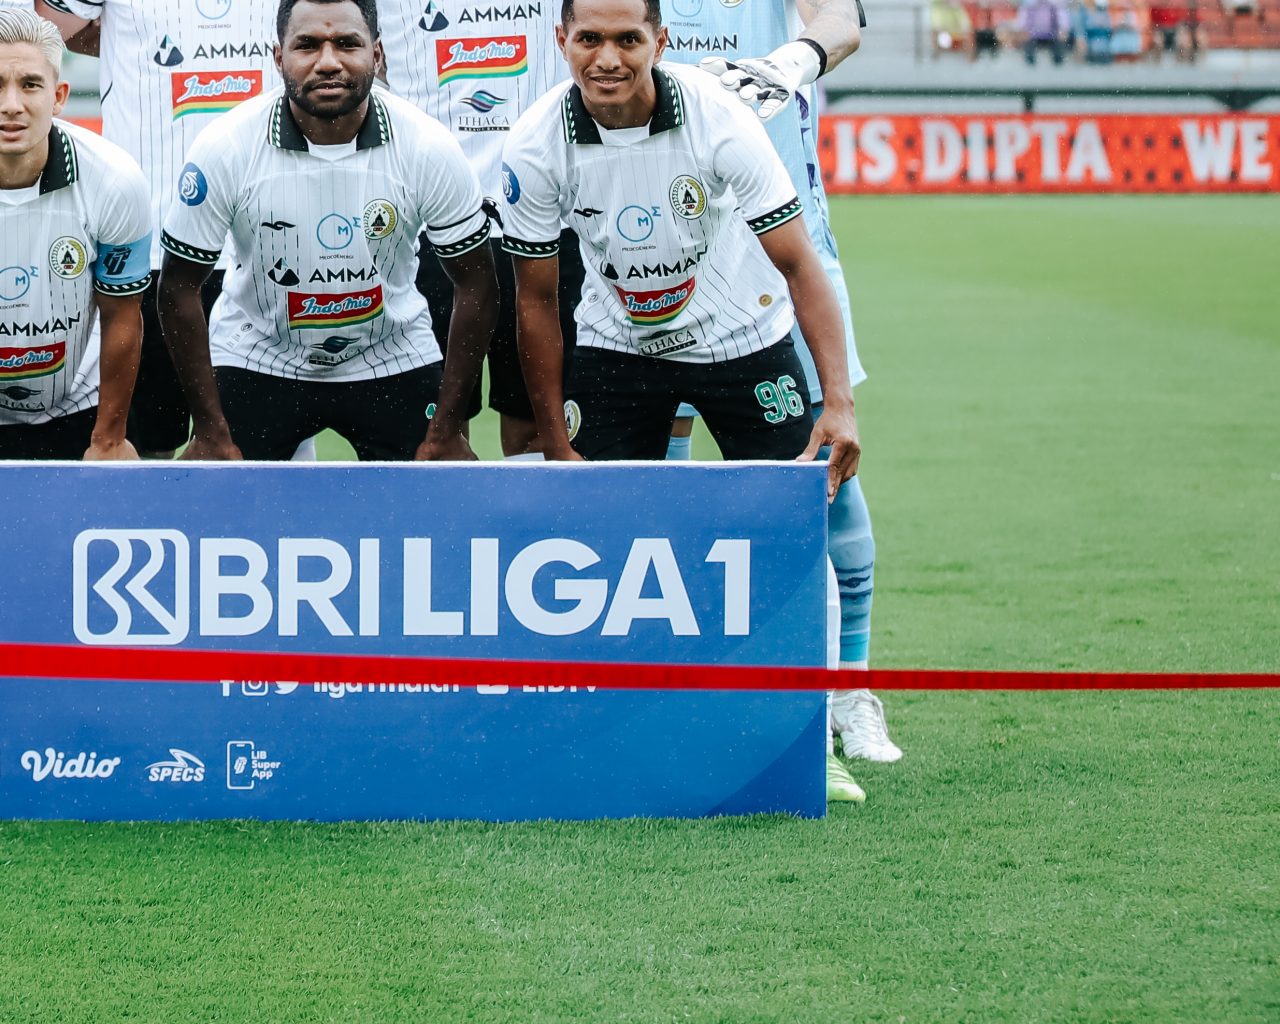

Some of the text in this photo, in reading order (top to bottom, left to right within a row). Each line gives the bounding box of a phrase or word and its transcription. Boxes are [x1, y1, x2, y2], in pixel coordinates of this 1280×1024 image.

[458, 2, 541, 24] AMMAN
[459, 116, 510, 125] ITHACA
[834, 119, 1273, 184] IS DIPTA WE
[308, 263, 379, 283] AMMA
[627, 245, 708, 279] AMMAN
[640, 330, 695, 355] ITHACA
[754, 375, 804, 423] 96
[199, 538, 380, 636] BRI
[21, 747, 121, 782] Vidio
[251, 750, 267, 760] LIB
[252, 759, 281, 770] Super
[148, 767, 206, 782] SPECS
[251, 770, 273, 780] App
